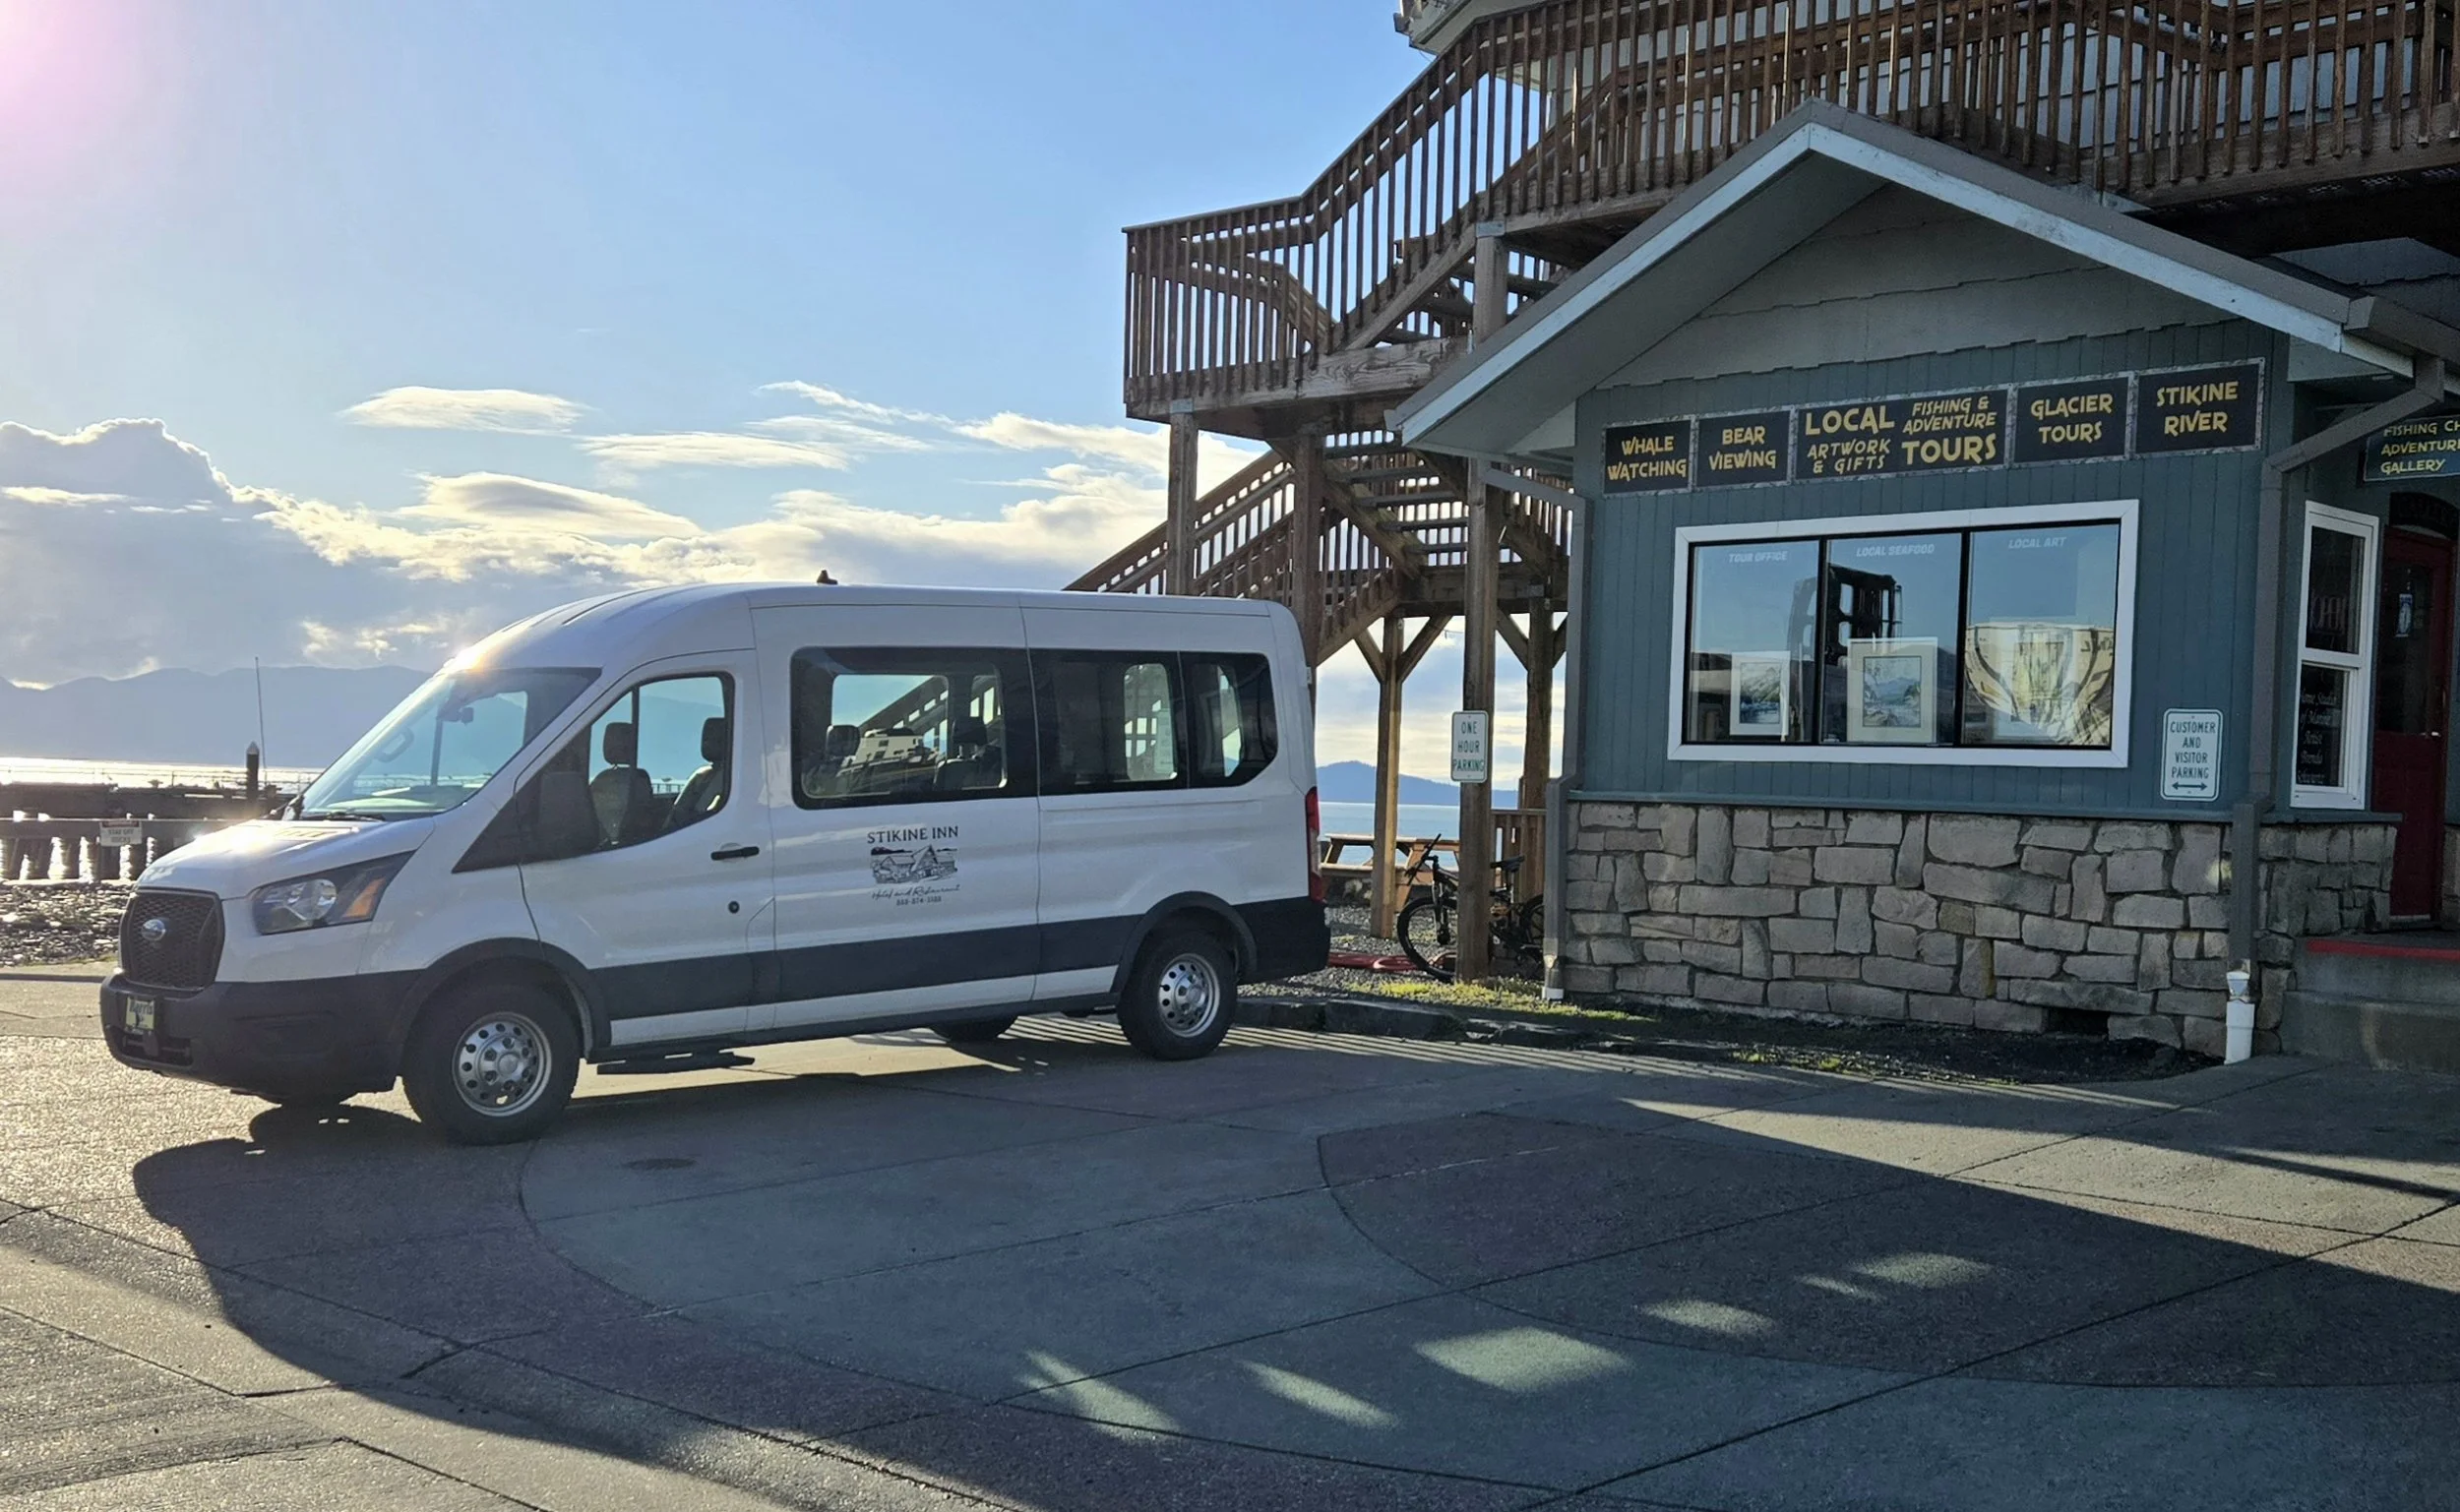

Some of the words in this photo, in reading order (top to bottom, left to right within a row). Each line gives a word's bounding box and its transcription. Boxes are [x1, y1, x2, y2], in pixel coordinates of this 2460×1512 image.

[2156, 381, 2239, 407] STIKINE
[1912, 397, 1972, 416] FISHING
[1977, 395, 1990, 410] &
[2030, 393, 2113, 420] GLACIER
[1805, 404, 1895, 436] LOCAL
[1902, 411, 1998, 435] ADVENTURE
[2164, 409, 2228, 437] RIVER
[2382, 422, 2437, 437] FISHING
[1722, 425, 1765, 446] BEAR
[2038, 420, 2103, 444] TOURS
[1621, 435, 1675, 457] WHALE
[1807, 438, 1891, 459] ARTWORK
[1901, 433, 1997, 465] TOURS
[1607, 458, 1687, 482] WATCHING
[1708, 450, 1777, 471] VIEWING
[1813, 459, 1824, 474] &
[1833, 454, 1885, 474] GIFTS
[2381, 458, 2446, 475] GALLERY
[1856, 546, 1886, 558] LOCAL
[1887, 544, 1935, 556] SEAFOOD
[2008, 538, 2042, 549] LOCAL
[2043, 536, 2067, 548] ART
[1728, 552, 1753, 564] TOUR
[1753, 550, 1788, 563] OFFICE
[1461, 721, 1478, 734] ONE
[2170, 721, 2216, 734] CUSTOMER
[1457, 740, 1480, 753] HOUR
[2182, 737, 2201, 749] AND
[1452, 758, 1485, 772] PARKING
[2175, 752, 2208, 764] VISITOR
[2171, 766, 2209, 779] PARKING
[867, 828, 928, 844] STIKINE
[932, 825, 958, 839] INN
